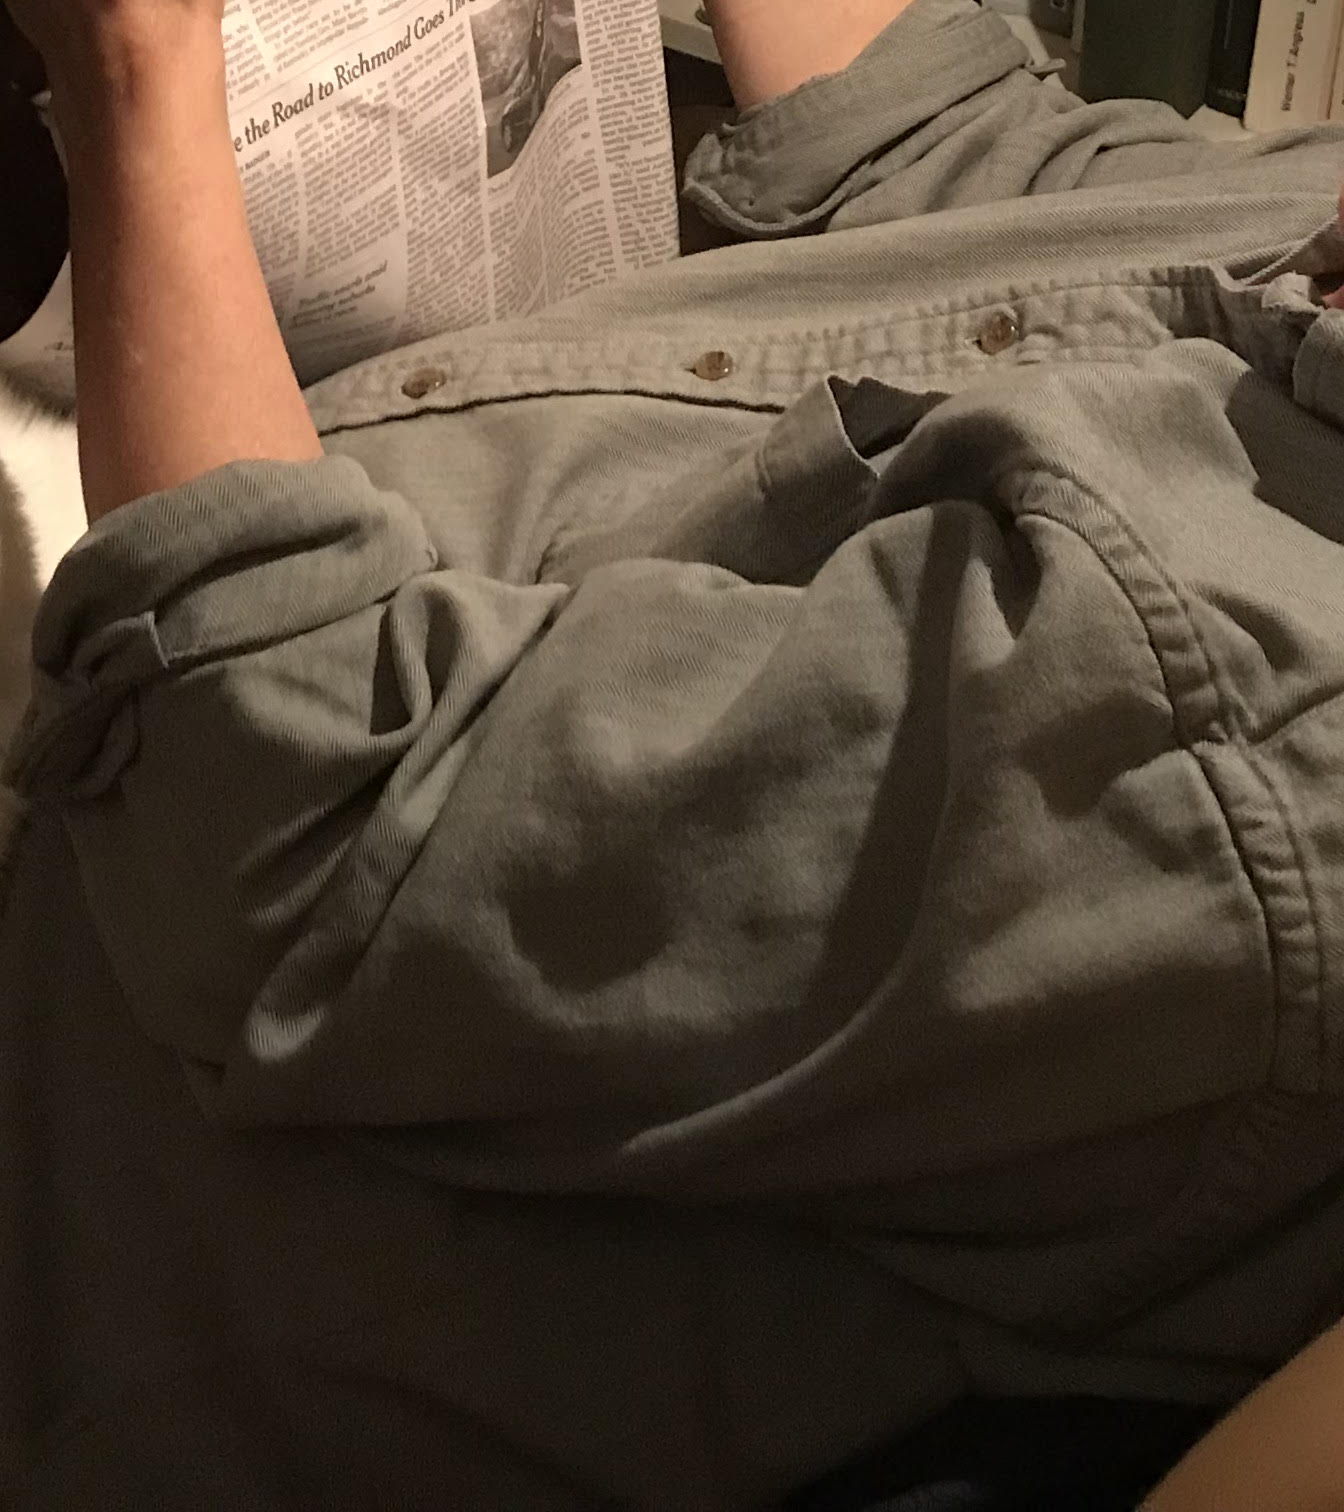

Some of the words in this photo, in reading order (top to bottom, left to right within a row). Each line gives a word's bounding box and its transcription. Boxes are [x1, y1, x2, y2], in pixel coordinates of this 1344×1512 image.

[244, 116, 271, 147] the
[270, 87, 314, 130] Road
[317, 77, 335, 102] to
[332, 25, 412, 91] Richmond
[413, 8, 445, 42] Goes
[1278, 71, 1297, 113] Werner
